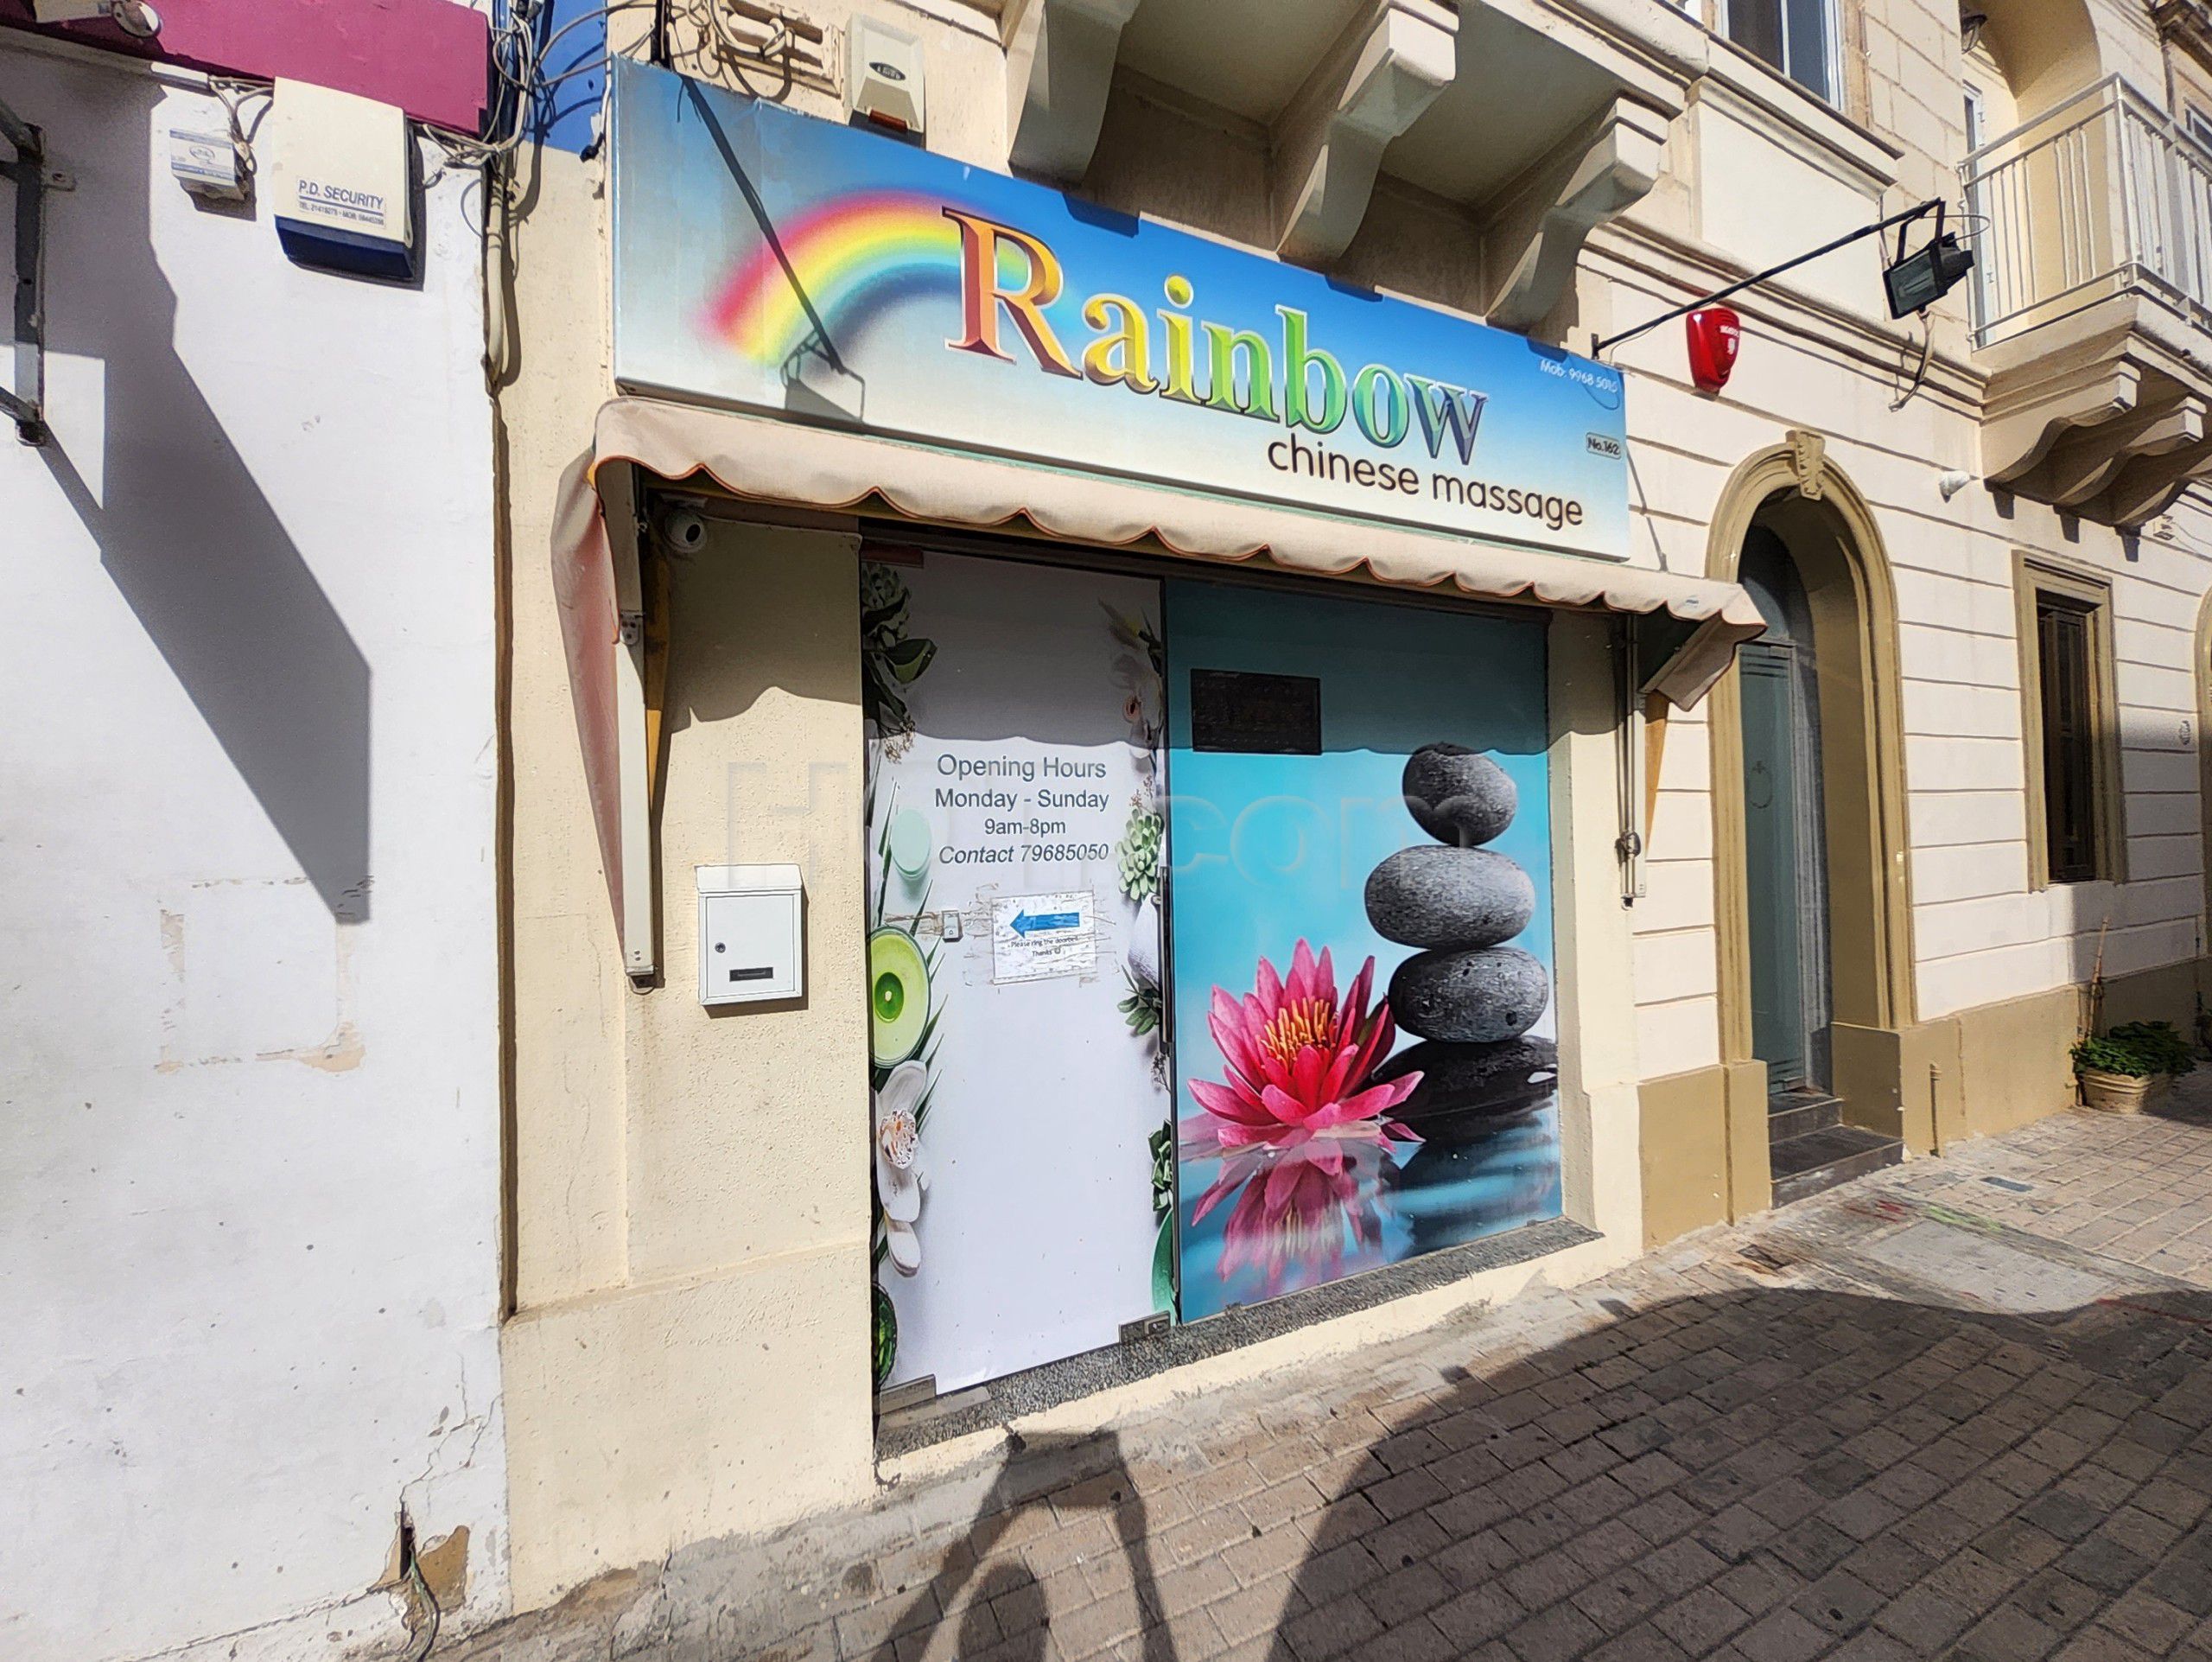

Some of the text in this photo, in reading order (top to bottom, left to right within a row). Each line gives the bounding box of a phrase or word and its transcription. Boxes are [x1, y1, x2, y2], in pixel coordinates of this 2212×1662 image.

[298, 180, 385, 210] P.D. SECURITY
[939, 206, 1488, 465] Rainbow
[1568, 368, 1594, 386] 9968
[1587, 437, 1620, 455] No.162
[1268, 433, 1584, 532] chinese massage
[937, 754, 1107, 782] Opening Hours
[935, 788, 1018, 812] Monday
[1037, 789, 1109, 812] Sunday
[984, 818, 1066, 837] 9am-8pm
[938, 843, 1109, 865] Contact 79685050
[1031, 939, 1043, 947] ring
